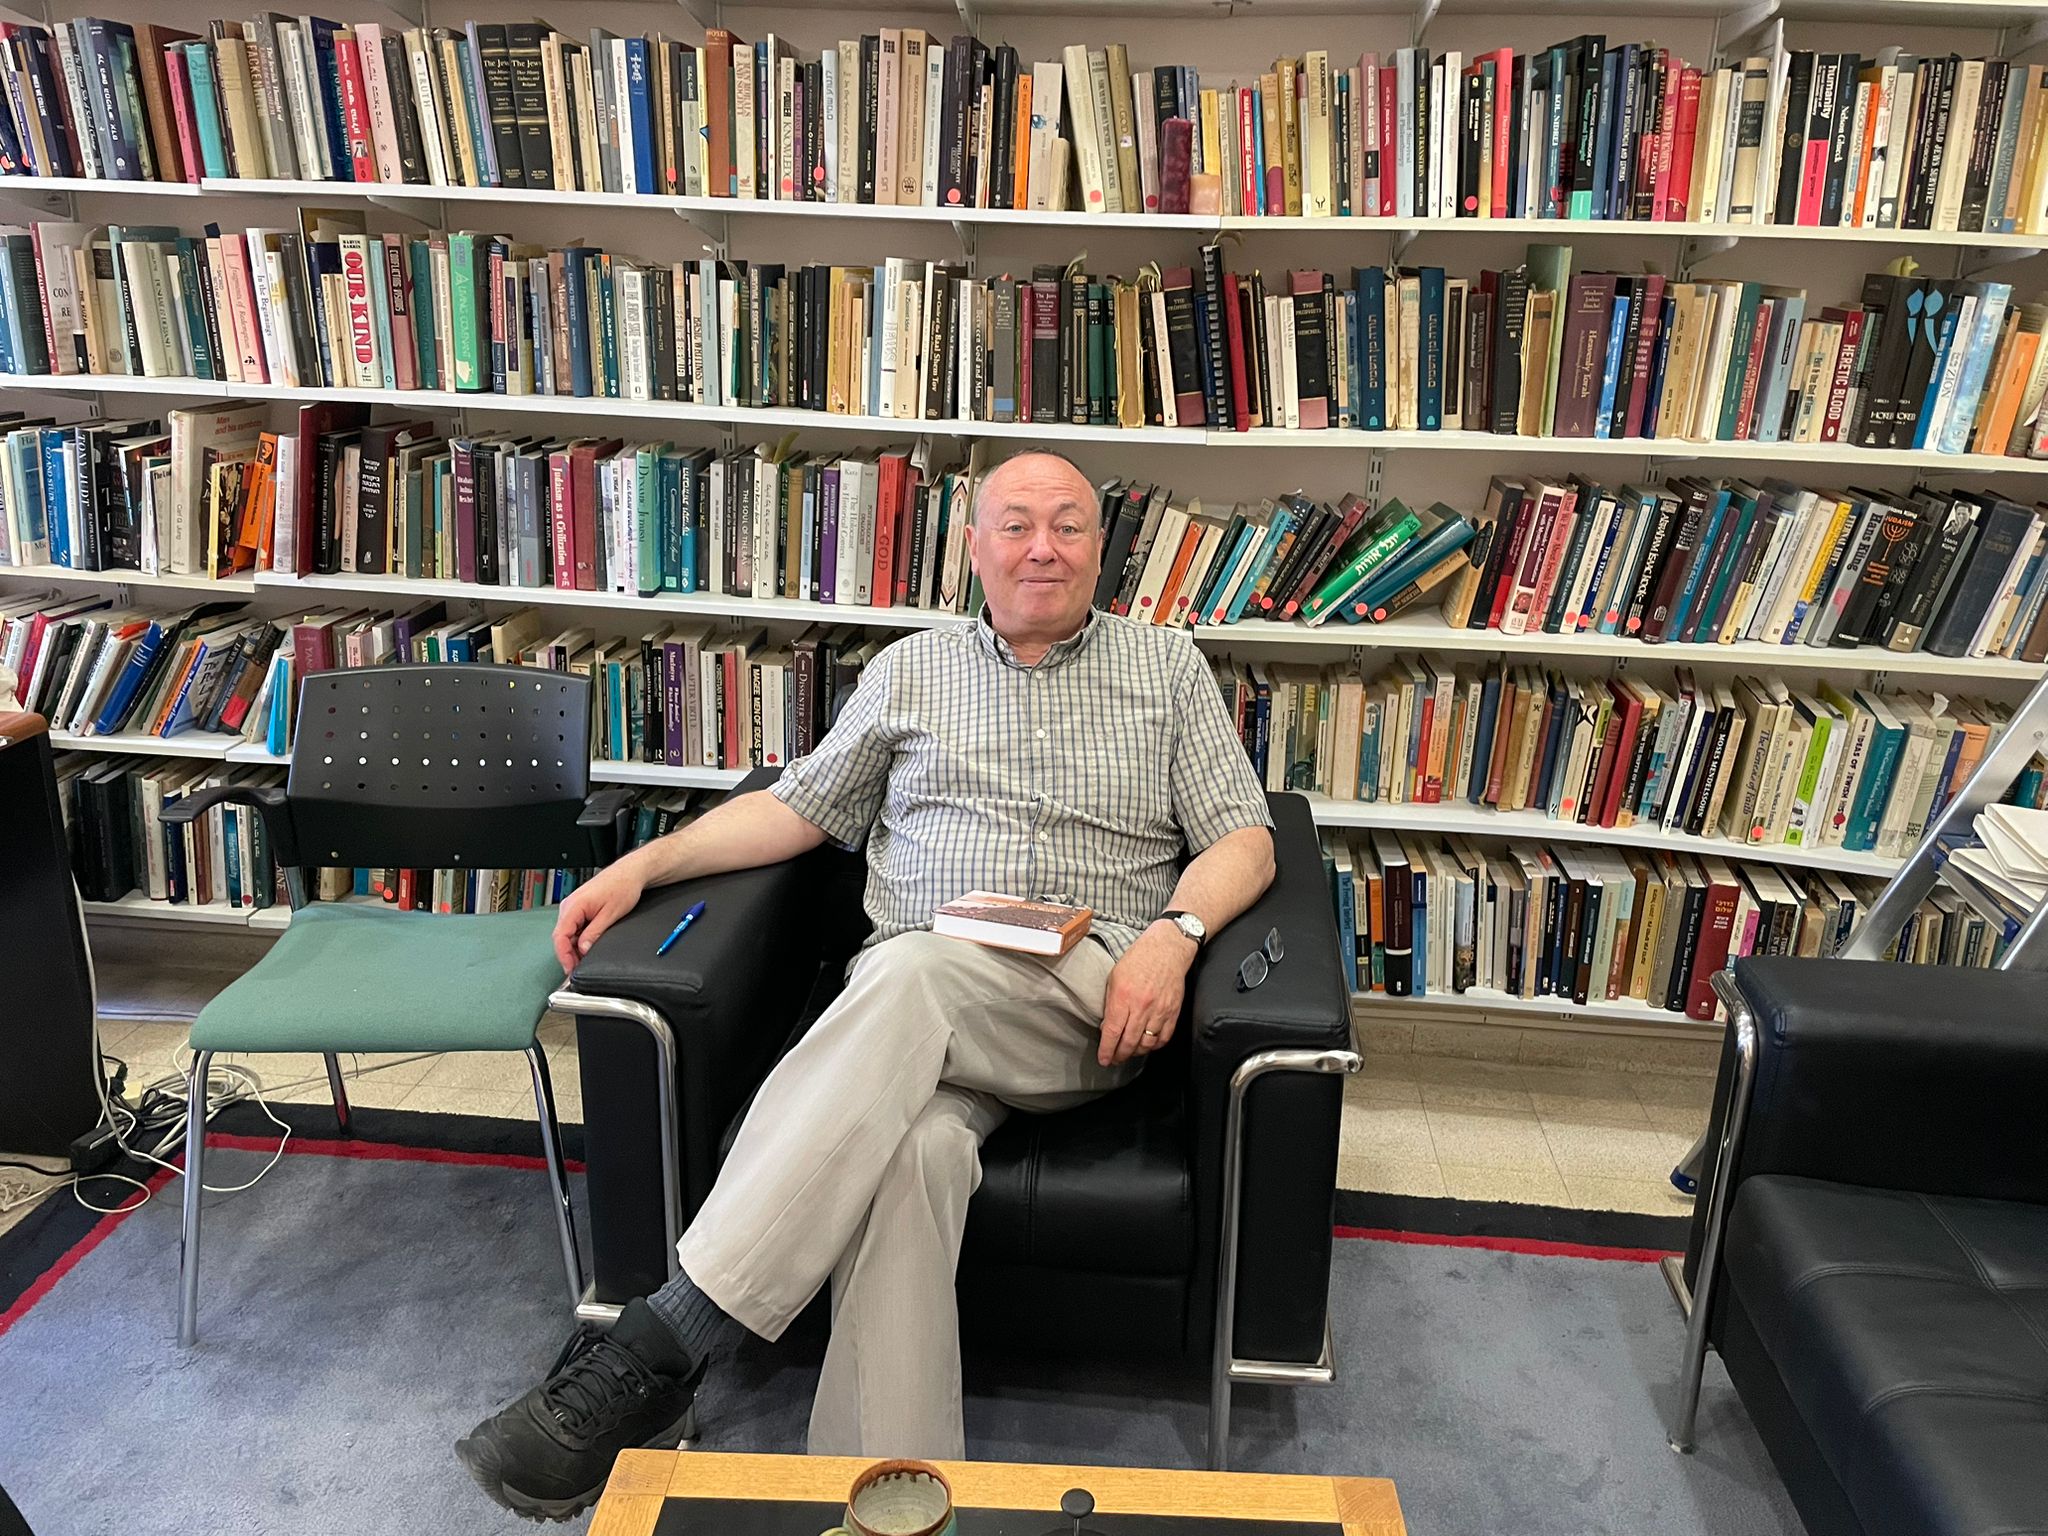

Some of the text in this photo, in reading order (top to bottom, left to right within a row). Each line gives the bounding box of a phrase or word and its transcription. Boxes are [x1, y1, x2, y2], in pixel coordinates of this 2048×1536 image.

[418, 71, 430, 108] TRUTH
[1820, 65, 1838, 120] humanity
[1837, 105, 1850, 134] Nelson
[1925, 89, 1952, 204] WHY SHOULD JEWS SURVIVE?
[1649, 152, 1658, 184] DEATH
[257, 275, 274, 337] In the Beginnings
[344, 252, 373, 364] OUR KIND
[1629, 287, 1643, 333] HESCHEL
[933, 334, 942, 352] Baal
[932, 353, 941, 375] Shem
[1580, 329, 1597, 398] Heavenly Torah
[1828, 344, 1856, 419] HERETIC BLOOD
[1941, 369, 1957, 398] ZION
[78, 434, 89, 467] TONY
[80, 473, 90, 507] JUDT
[552, 467, 565, 502] Judaism
[841, 492, 849, 528] Historical
[848, 496, 859, 549] The Holocaust
[1864, 512, 1883, 541] Hans
[557, 520, 568, 566] Civilization
[877, 535, 890, 571] GOD
[1759, 729, 1772, 746] The
[1697, 734, 1726, 818] MOSES MENDELSSOHN
[1742, 790, 1756, 815] Faith
